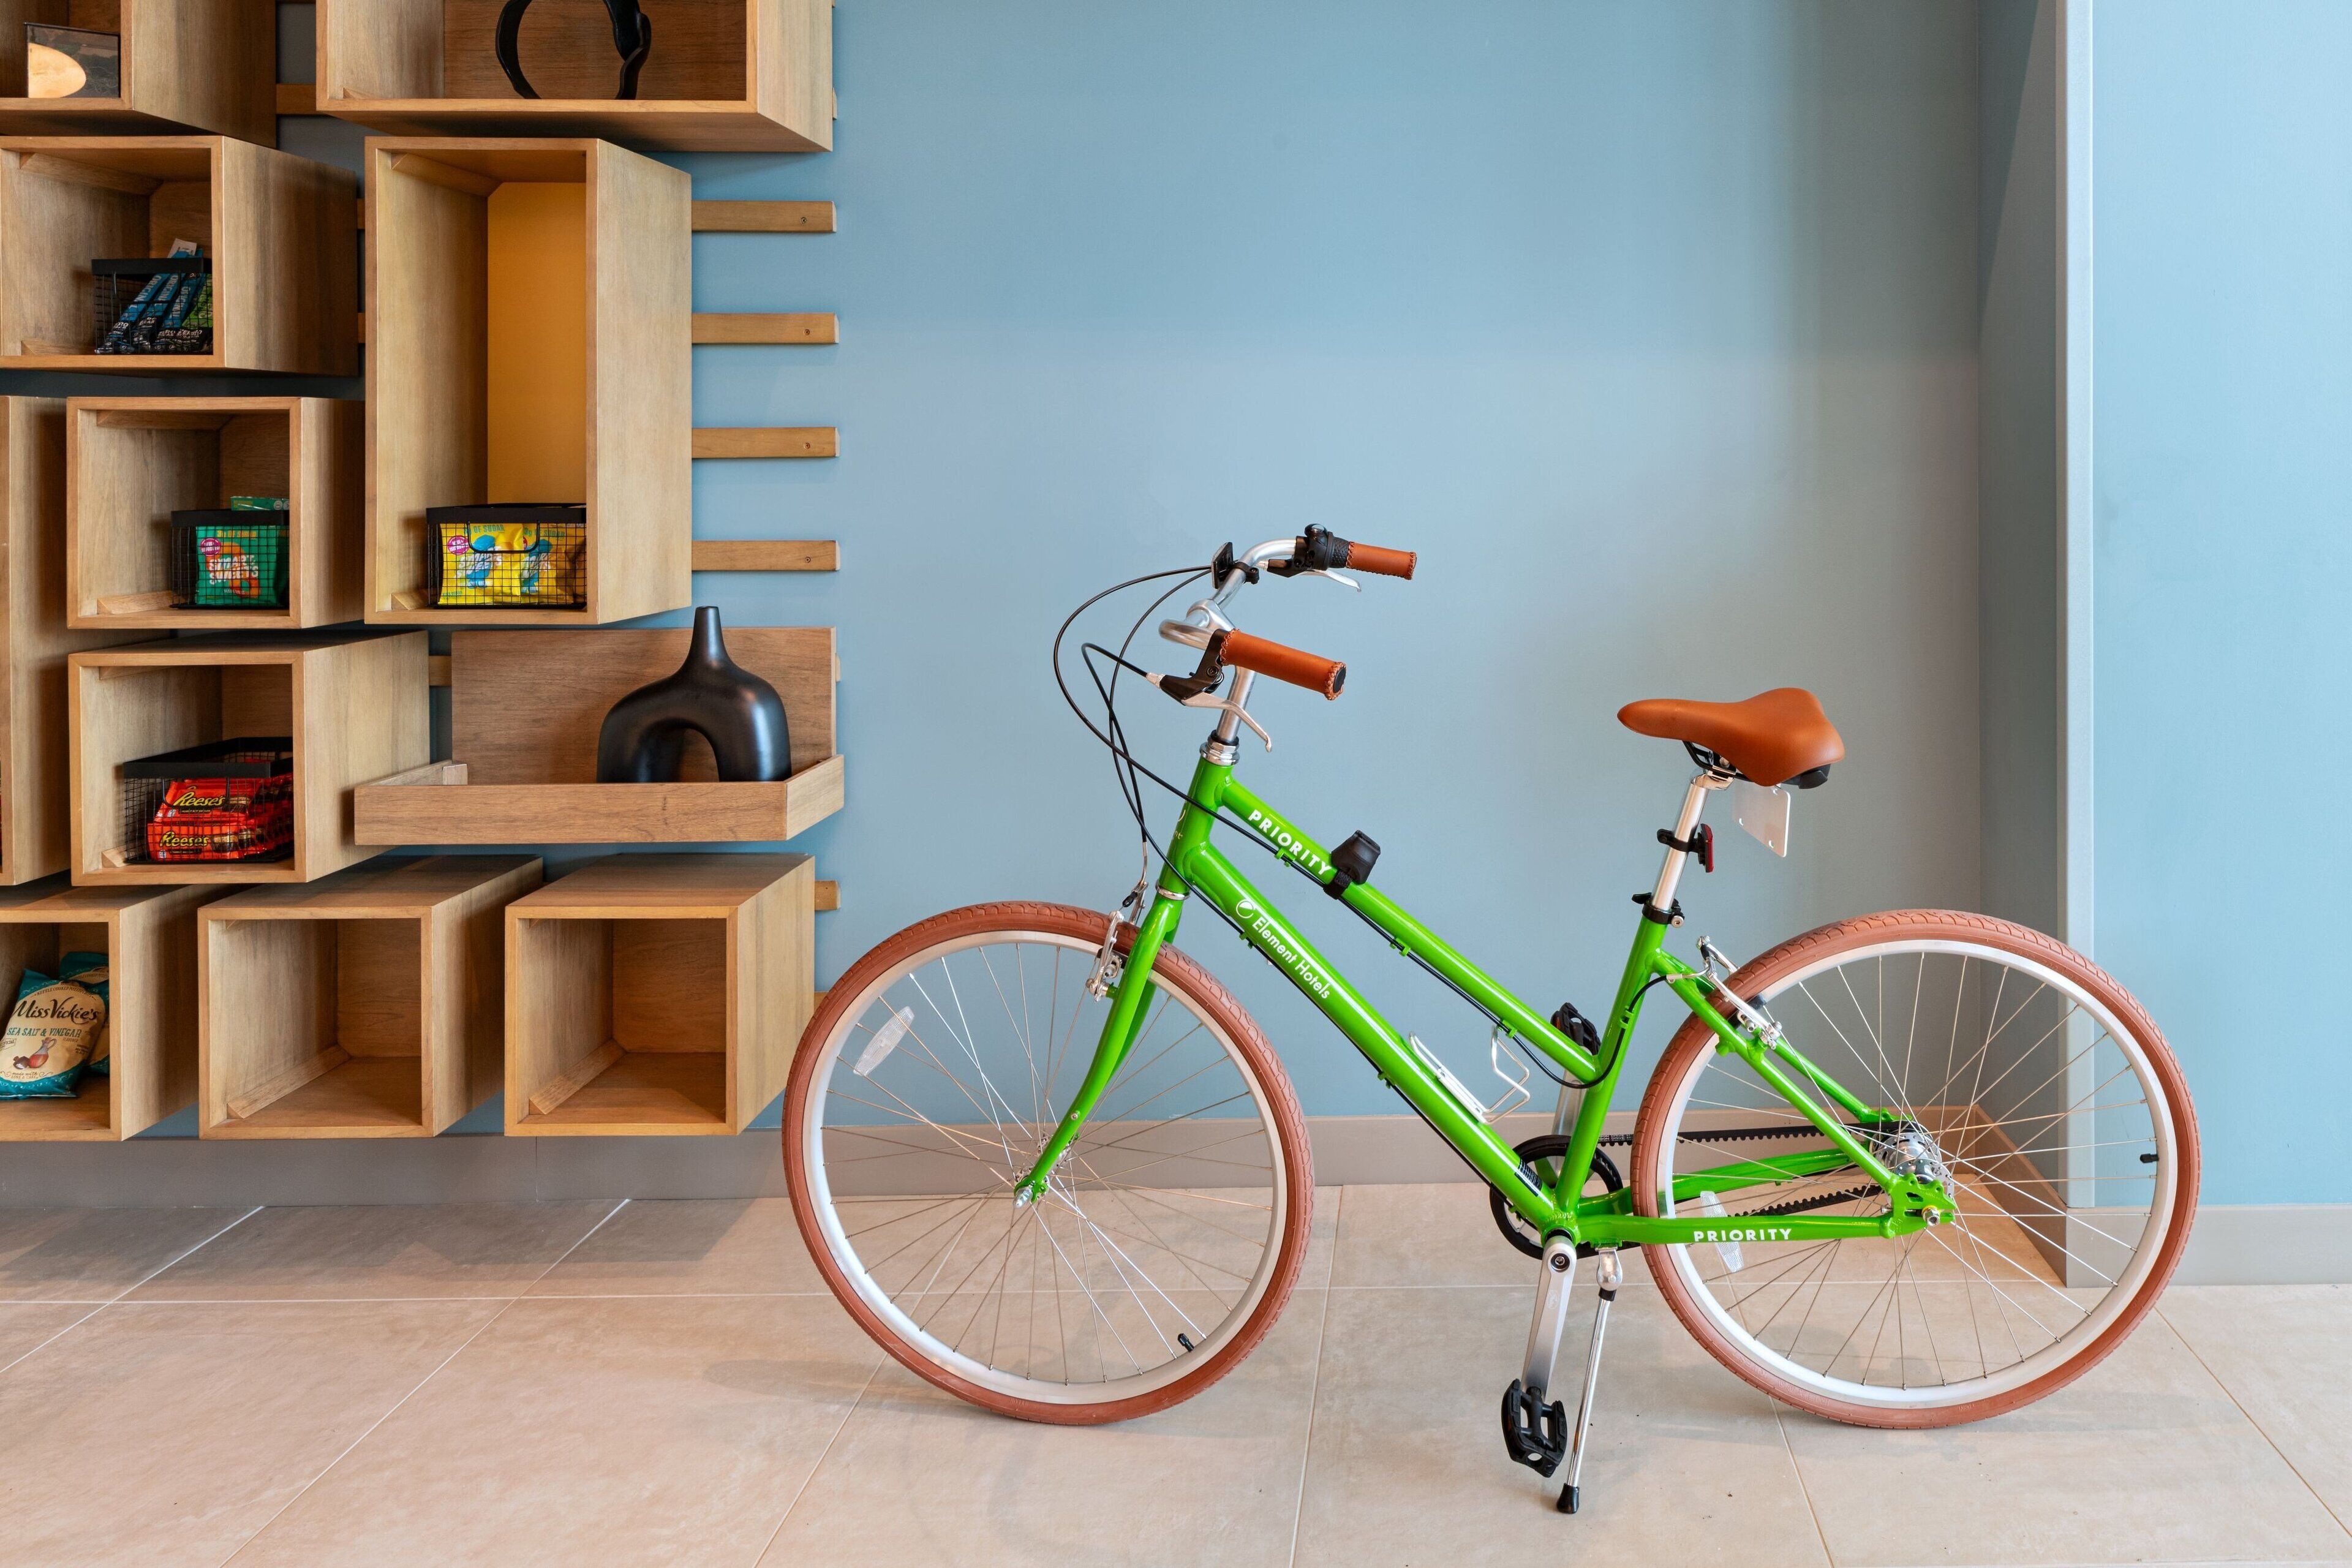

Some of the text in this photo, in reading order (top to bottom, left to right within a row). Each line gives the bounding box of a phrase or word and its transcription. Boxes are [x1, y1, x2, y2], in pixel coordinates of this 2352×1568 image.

[129, 274, 162, 309] ORIGINL
[209, 554, 255, 571] SMART
[209, 565, 258, 585] SWEETS
[1248, 809, 1332, 876] PRIORITY
[1252, 917, 1330, 1000] Element Hotels
[10, 996, 100, 1025] Miss Vickie's
[7, 1027, 20, 1036] SEA
[22, 1028, 40, 1036] SALT
[49, 1028, 82, 1038] VINEGAR
[1694, 1228, 1792, 1242] PRIORITY
